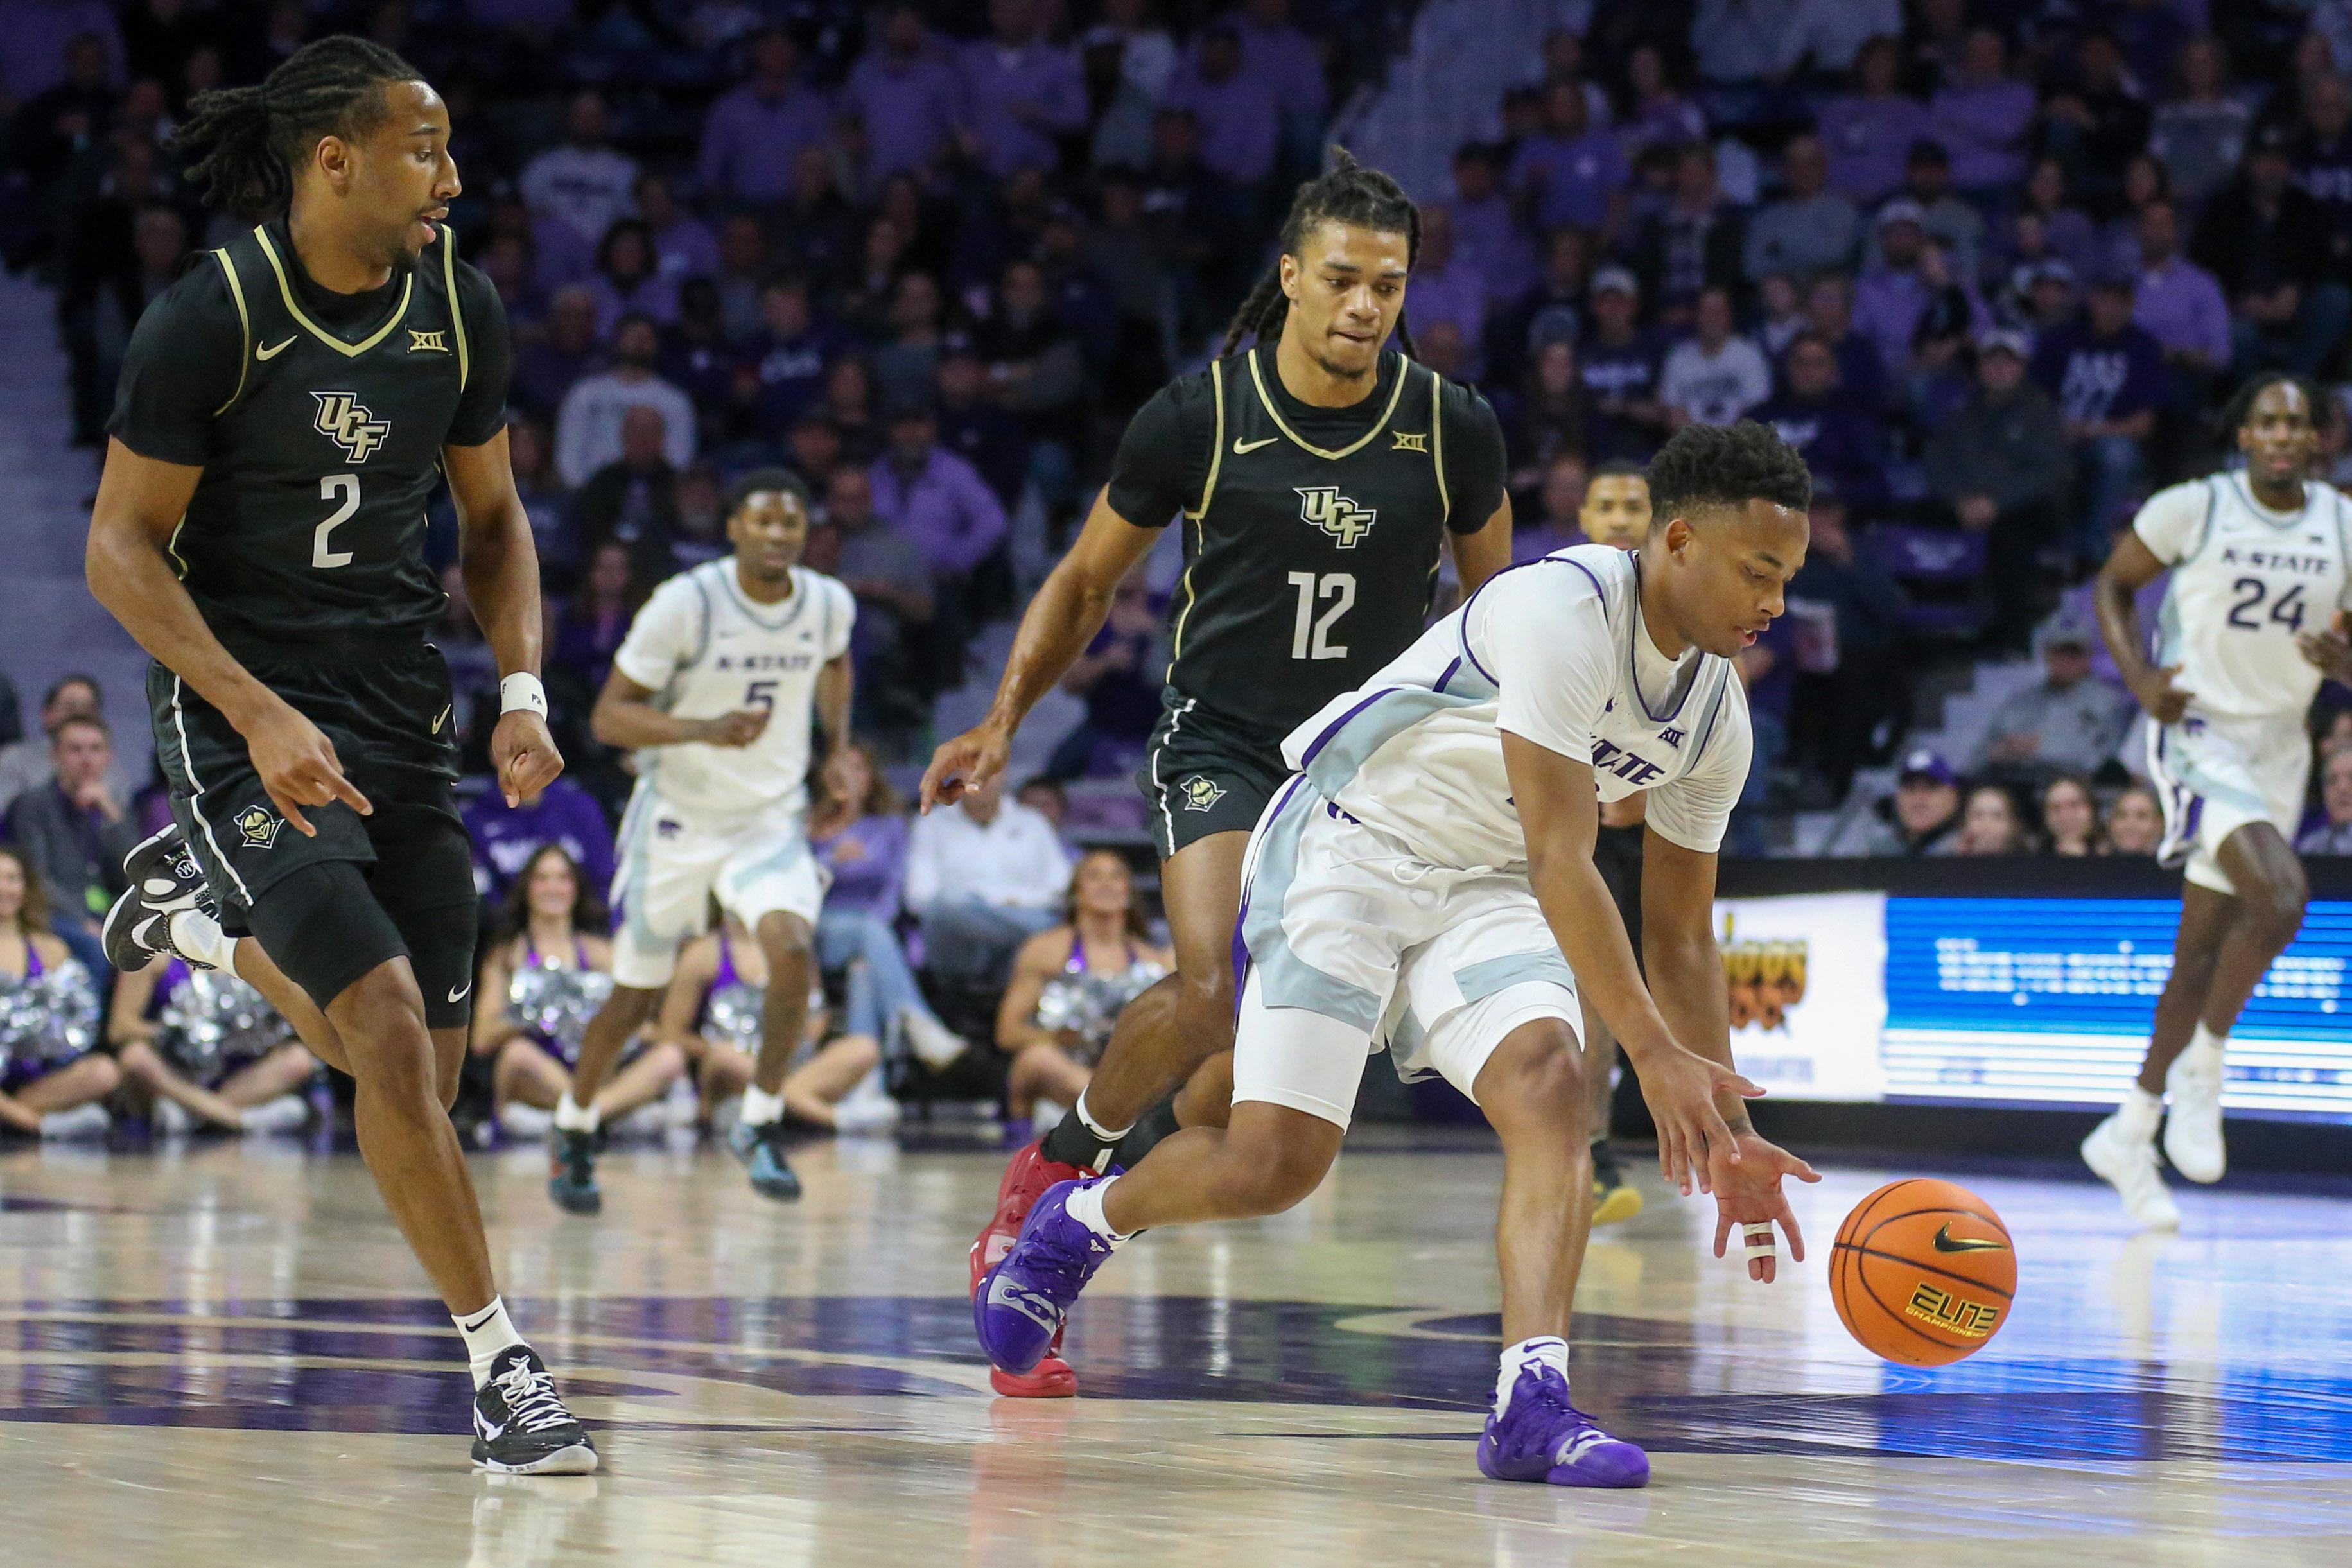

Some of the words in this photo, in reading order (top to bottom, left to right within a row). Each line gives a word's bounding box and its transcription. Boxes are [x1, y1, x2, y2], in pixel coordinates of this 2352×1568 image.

[407, 329, 449, 353] XII
[311, 392, 390, 462] UCF
[1391, 430, 1428, 453] XII
[312, 473, 361, 568] 2
[1296, 486, 1376, 548] UCF
[1287, 571, 1357, 660] 12
[2227, 577, 2306, 633] 24
[745, 679, 780, 724] 5
[1657, 727, 1685, 749] XII
[1909, 1281, 2001, 1333] ELITE
